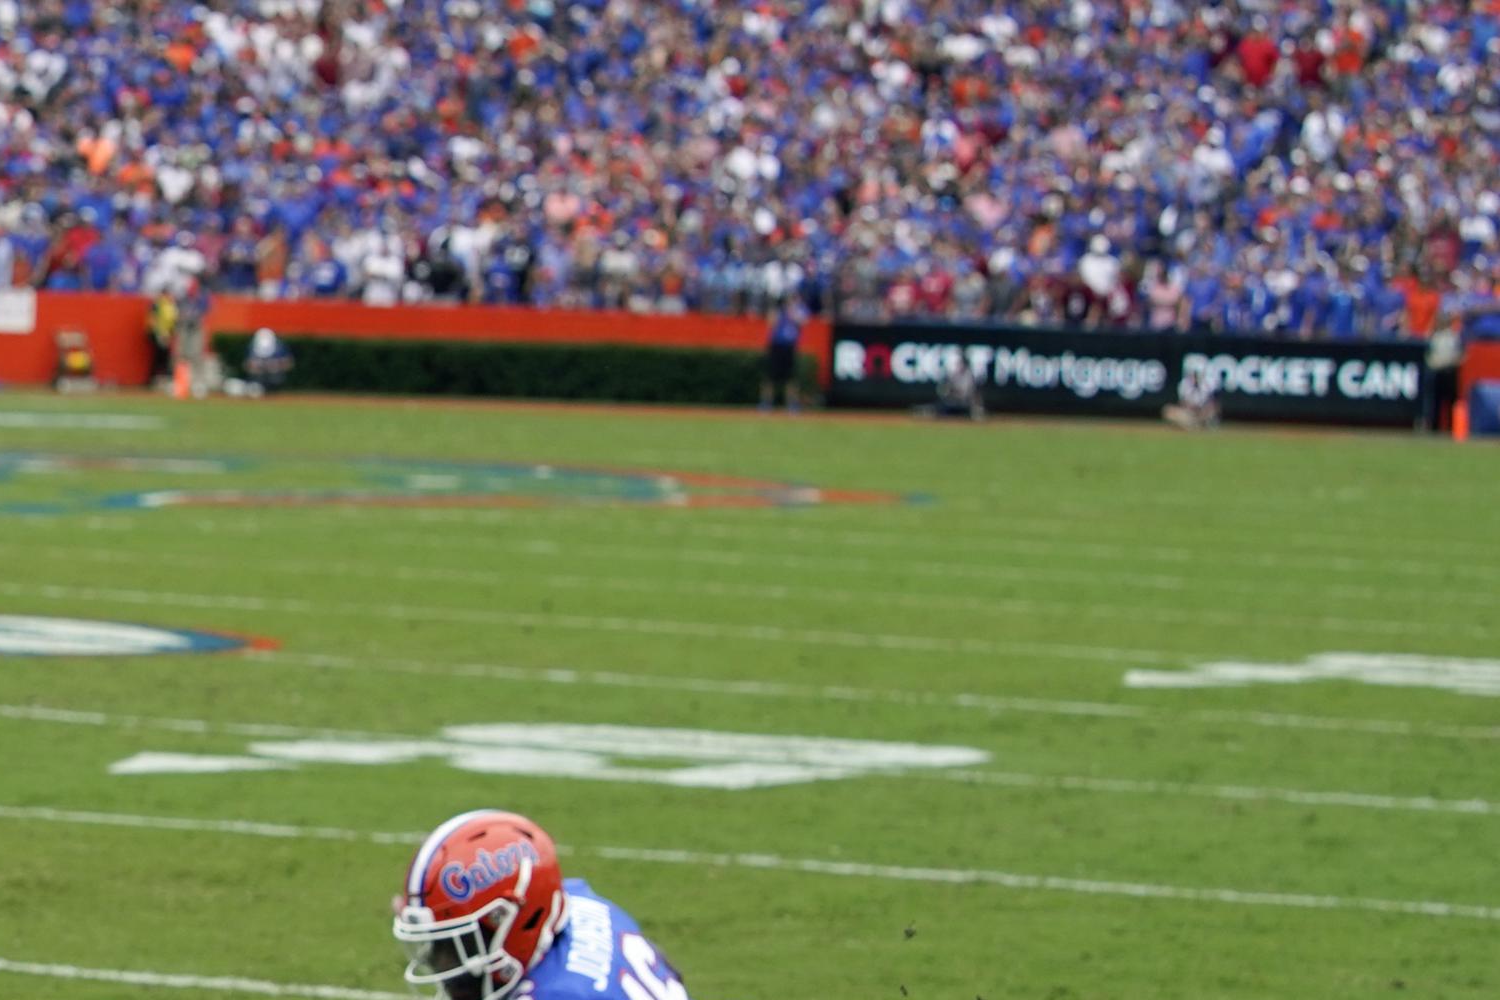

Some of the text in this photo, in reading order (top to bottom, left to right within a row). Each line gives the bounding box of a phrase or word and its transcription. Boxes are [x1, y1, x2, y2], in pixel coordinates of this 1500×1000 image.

[834, 340, 1168, 398] ROCKET Mortgage
[1337, 359, 1419, 400] CAN
